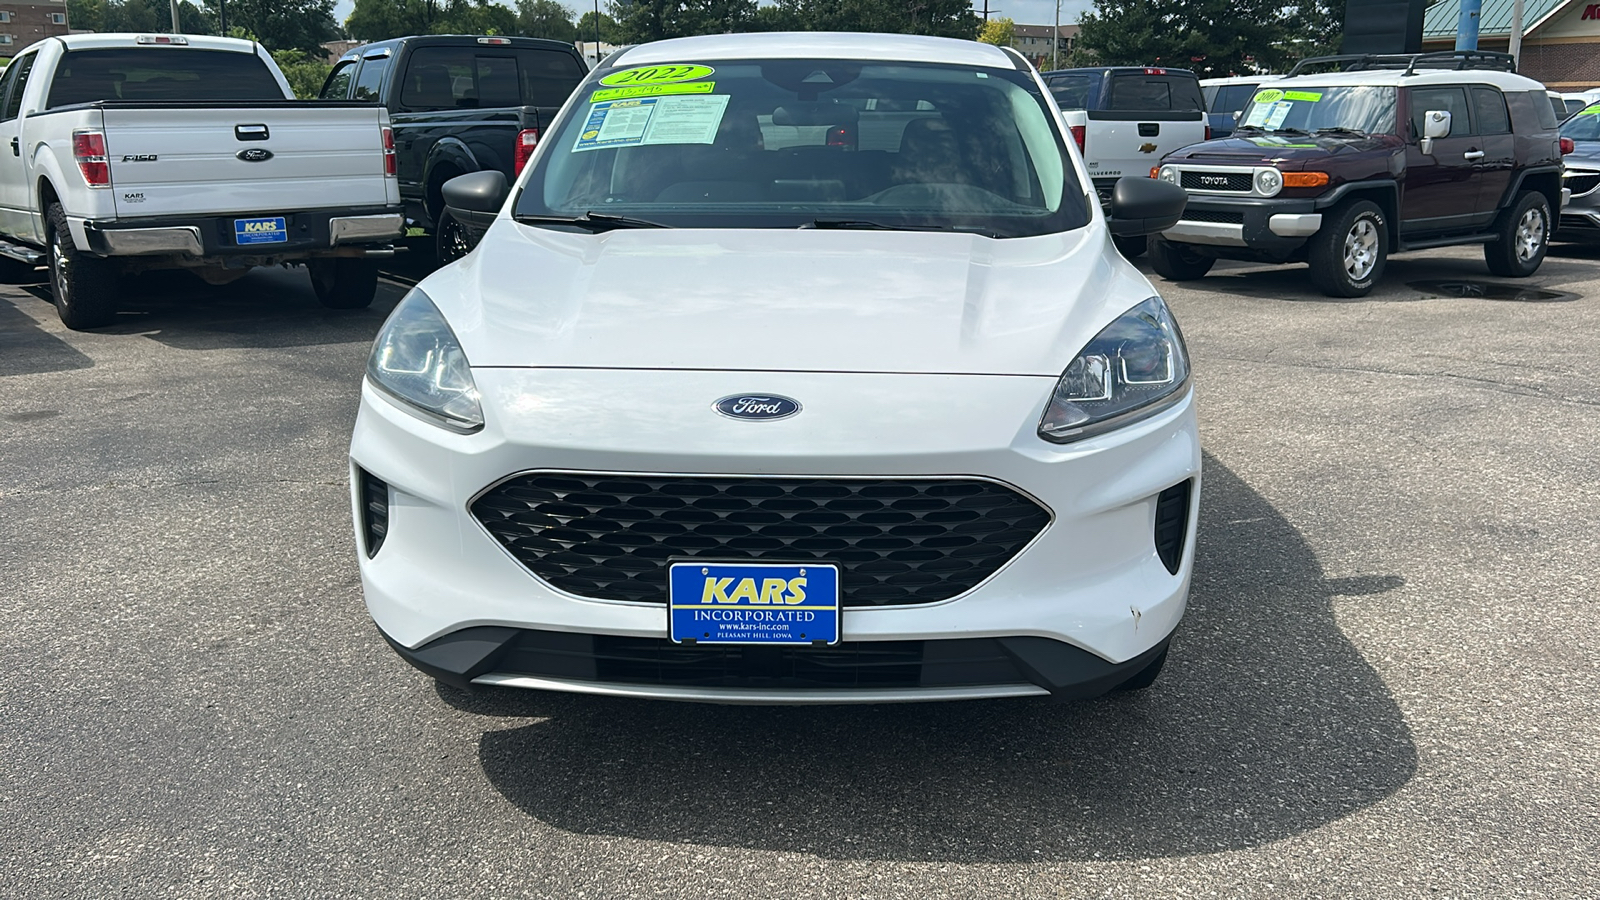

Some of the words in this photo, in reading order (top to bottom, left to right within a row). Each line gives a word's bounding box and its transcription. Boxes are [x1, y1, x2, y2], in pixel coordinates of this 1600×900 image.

[615, 66, 695, 84] 2022
[121, 154, 158, 163] F-150
[1200, 176, 1229, 186] TOYOTA
[245, 222, 277, 232] KARS
[732, 396, 782, 414] Ford
[701, 576, 808, 605] KARS
[694, 610, 815, 622] INCORPORATED
[719, 622, 789, 631] www.kars-inc.com
